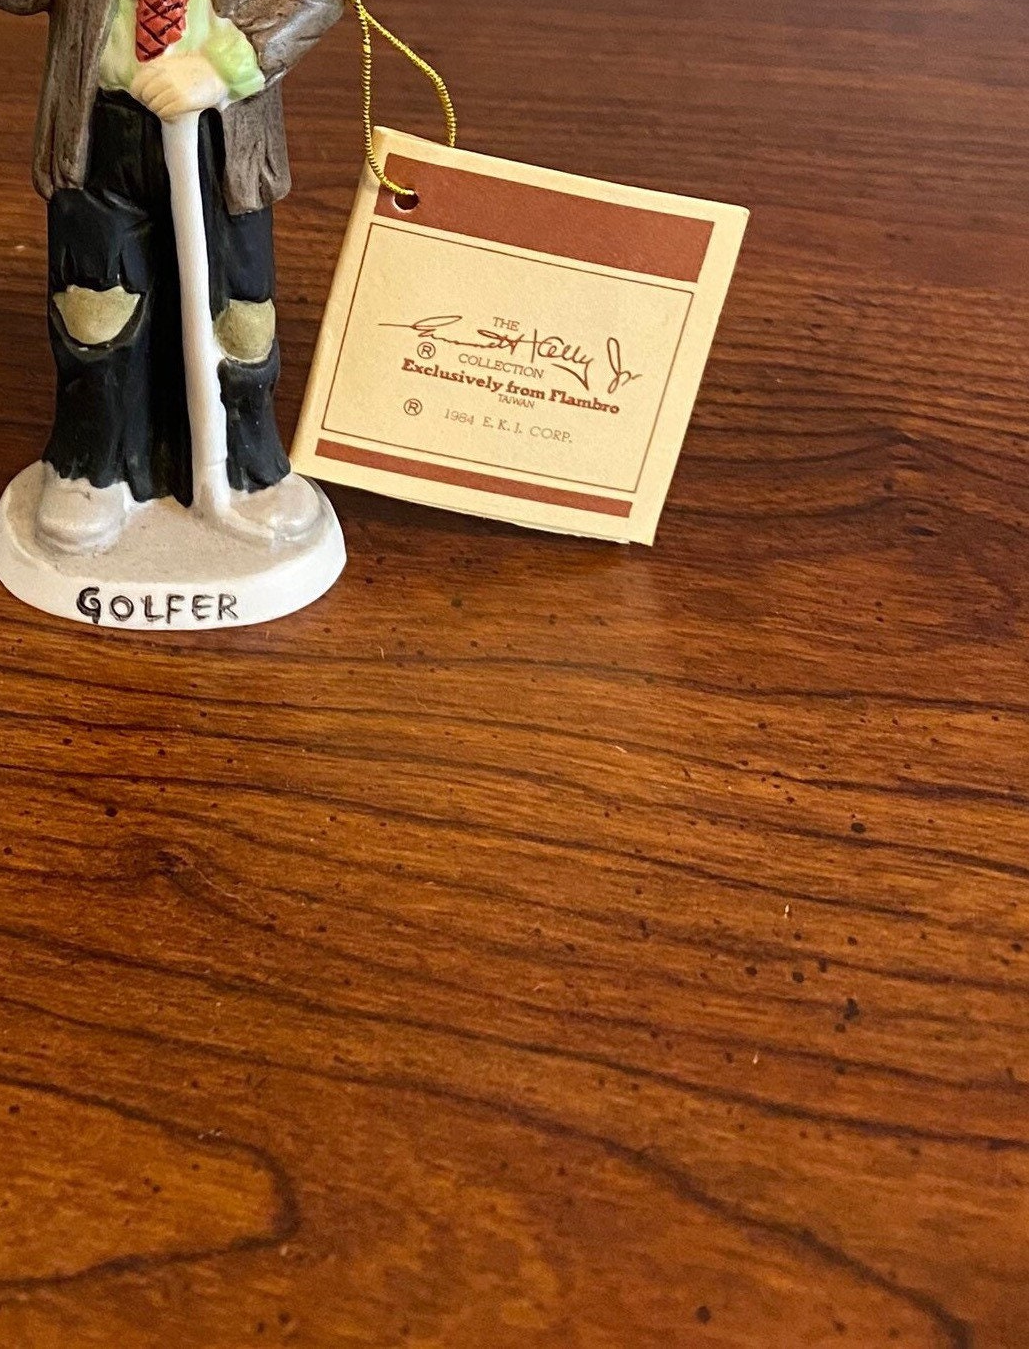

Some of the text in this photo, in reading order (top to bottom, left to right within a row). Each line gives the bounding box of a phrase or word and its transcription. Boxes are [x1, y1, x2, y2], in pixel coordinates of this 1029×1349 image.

[492, 316, 520, 332] THE
[458, 352, 546, 380] COLLECTION
[401, 357, 621, 415] Exclusively from Flambro
[497, 393, 536, 410] TAIWAN
[444, 408, 475, 426] 1984
[529, 425, 573, 443] CORP.
[75, 585, 239, 625] GOLFER
